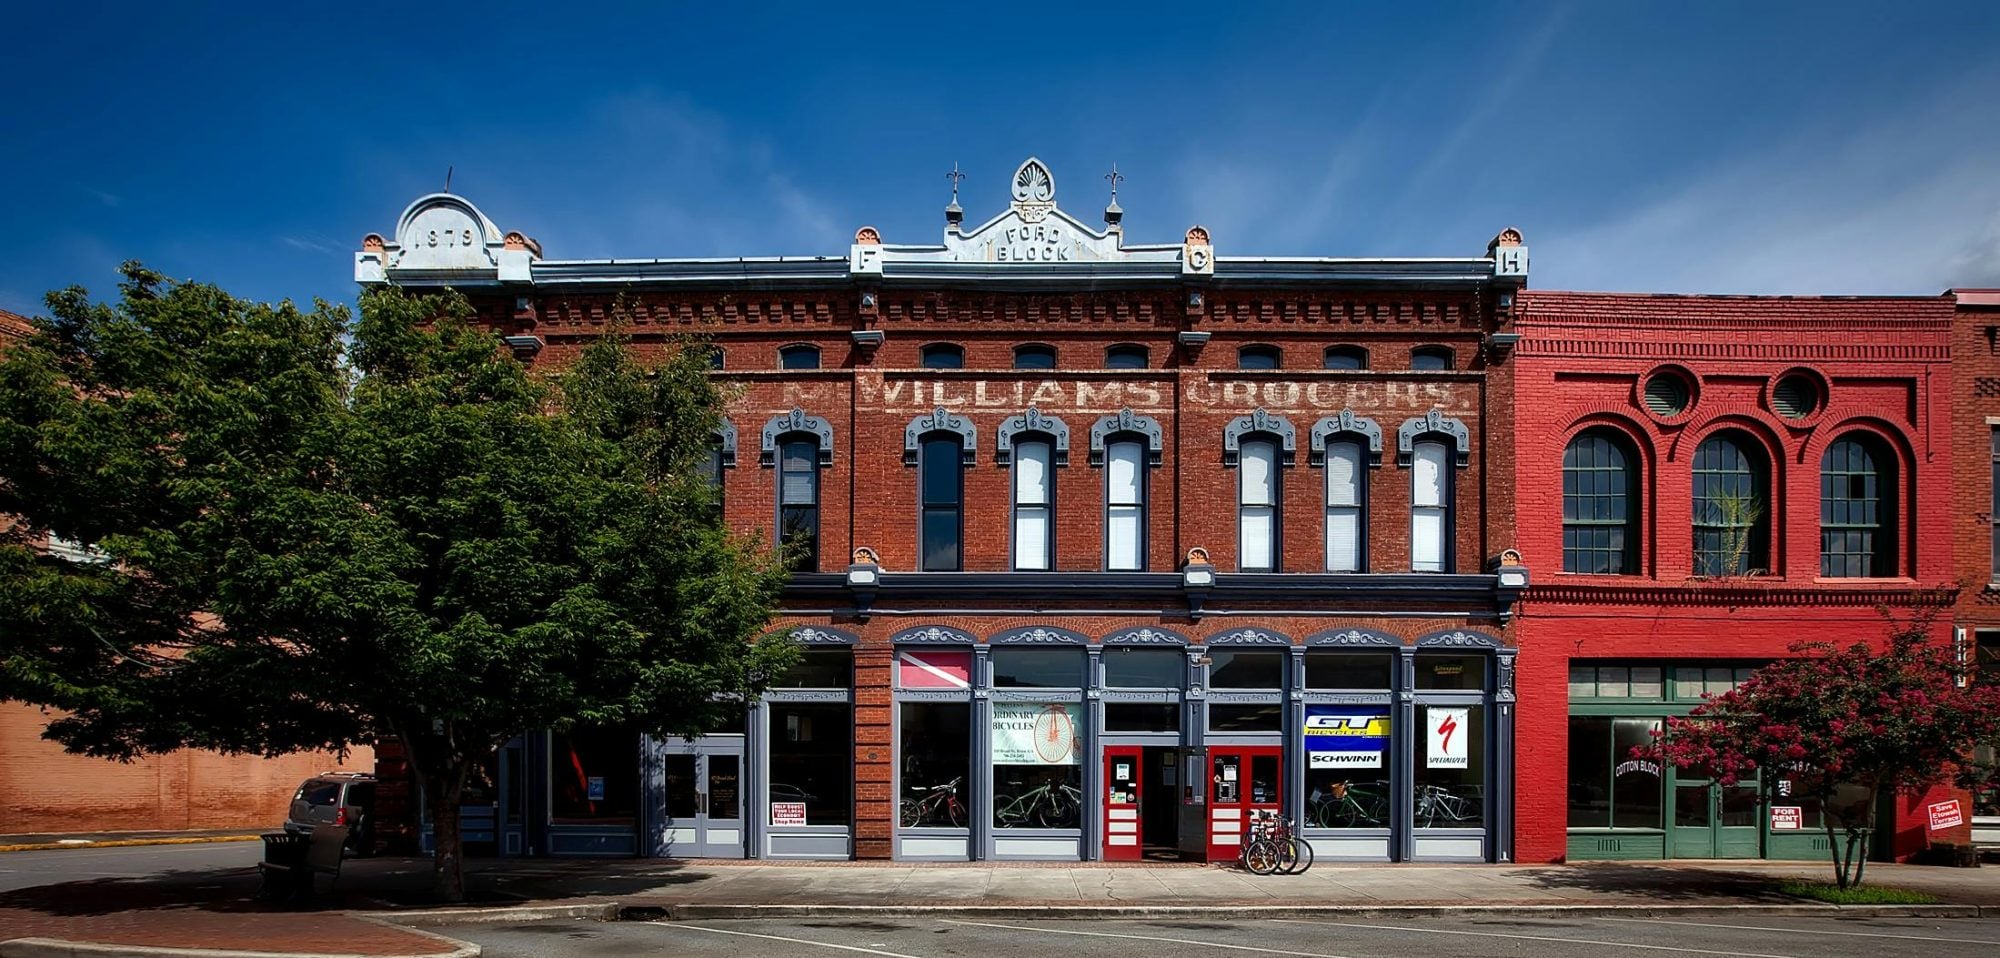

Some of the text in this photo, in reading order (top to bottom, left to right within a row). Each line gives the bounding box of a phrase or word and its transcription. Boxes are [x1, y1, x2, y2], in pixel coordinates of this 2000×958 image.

[1006, 226, 1059, 244] FORD
[859, 250, 877, 270] F
[997, 247, 1068, 261] BLOCK
[1502, 251, 1520, 273] H
[993, 722, 1034, 730] BICYCLES
[1306, 716, 1391, 729] GT
[1616, 760, 1660, 777] COTTON BLOCK
[1936, 804, 1953, 812] Save
